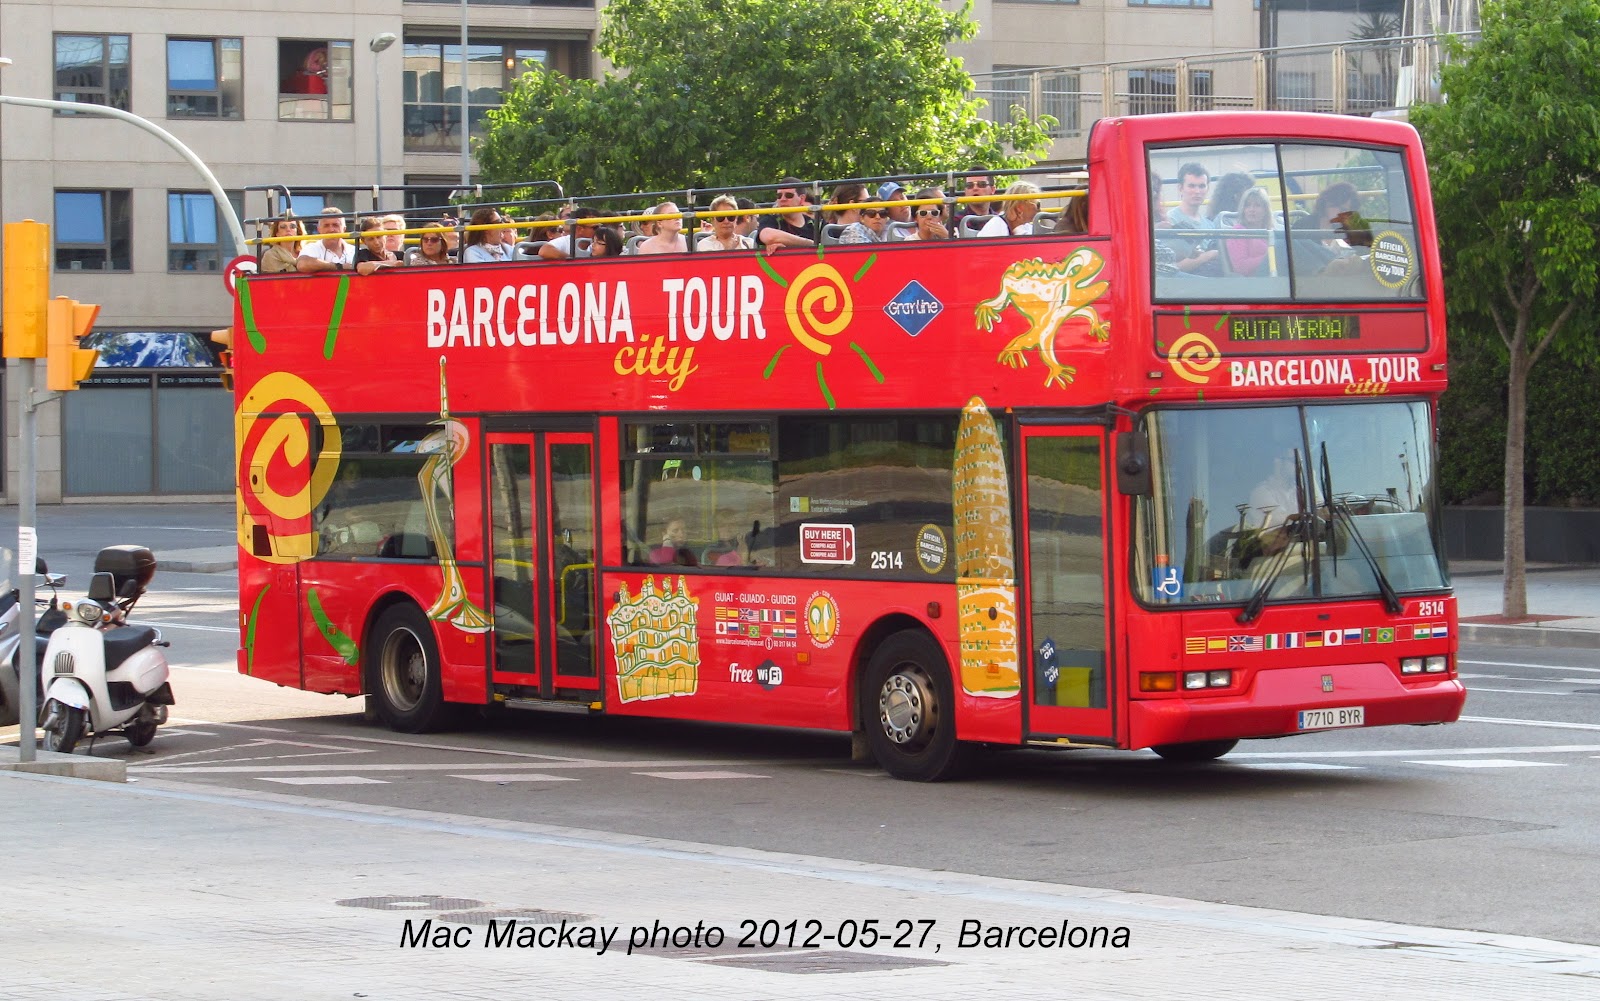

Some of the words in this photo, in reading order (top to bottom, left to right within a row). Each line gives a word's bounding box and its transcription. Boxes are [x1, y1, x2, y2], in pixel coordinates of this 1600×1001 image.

[1380, 241, 1404, 253] OFFICIAL
[1375, 251, 1409, 264] BARCELONA
[427, 281, 634, 348] BARCELONA
[663, 275, 766, 342] TOUR
[1234, 320, 1280, 340] RUTA
[1286, 318, 1342, 340] VERDA
[614, 334, 698, 392] city
[1231, 359, 1354, 387] BARCELONA
[1367, 357, 1421, 383] TOUR
[1344, 378, 1390, 397] city
[804, 530, 820, 539] BUY
[821, 530, 842, 540] HERE
[870, 551, 903, 569] 2514
[715, 592, 734, 602] GUIAT
[740, 593, 765, 604] GUIADO
[771, 594, 797, 604] GUIDED
[1419, 600, 1444, 615] 2514
[729, 662, 754, 683] Free
[1307, 711, 1334, 727] 7710
[1339, 709, 1361, 724] BYR
